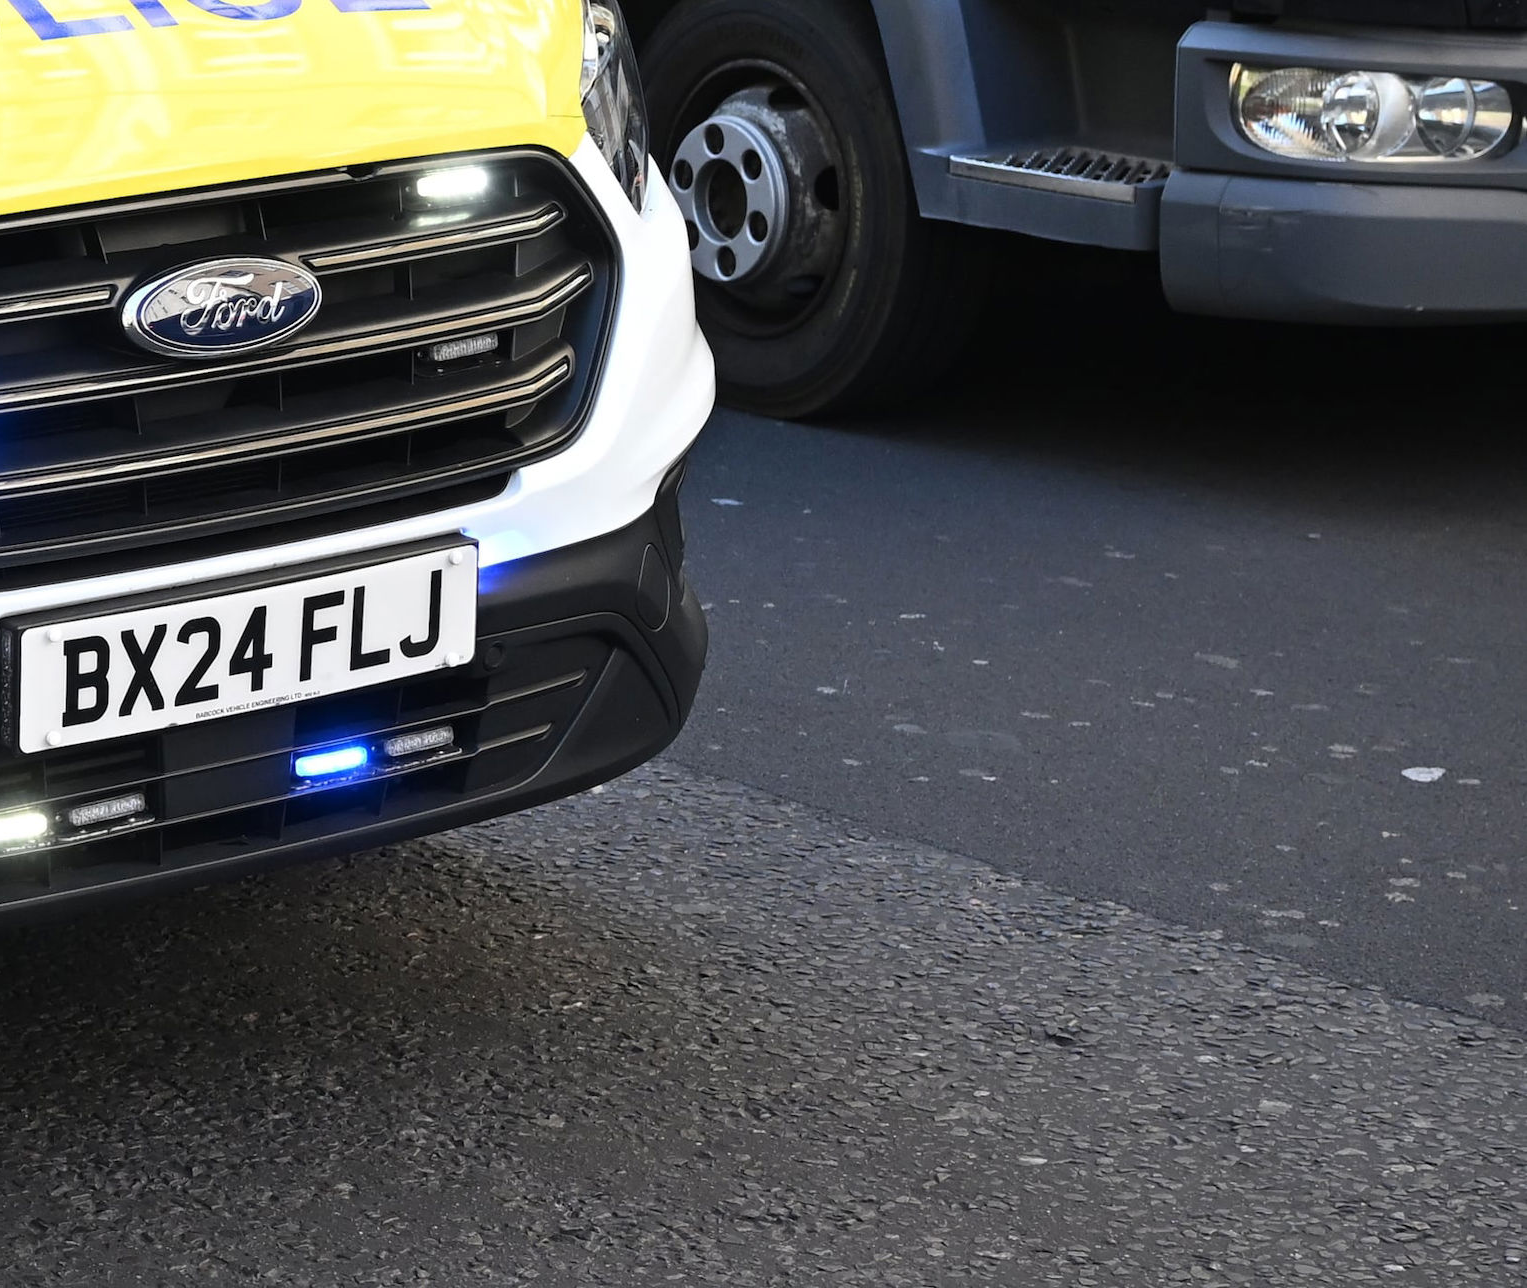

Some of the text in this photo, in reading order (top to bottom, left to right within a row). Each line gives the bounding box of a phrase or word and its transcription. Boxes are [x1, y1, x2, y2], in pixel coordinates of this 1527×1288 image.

[179, 273, 288, 337] Ford
[60, 568, 444, 729] BX24 FLJ
[195, 708, 225, 720] BABCOCK
[226, 702, 251, 714] VEHICLE
[251, 694, 290, 709] ENGINEERING
[290, 691, 302, 701] LTD
